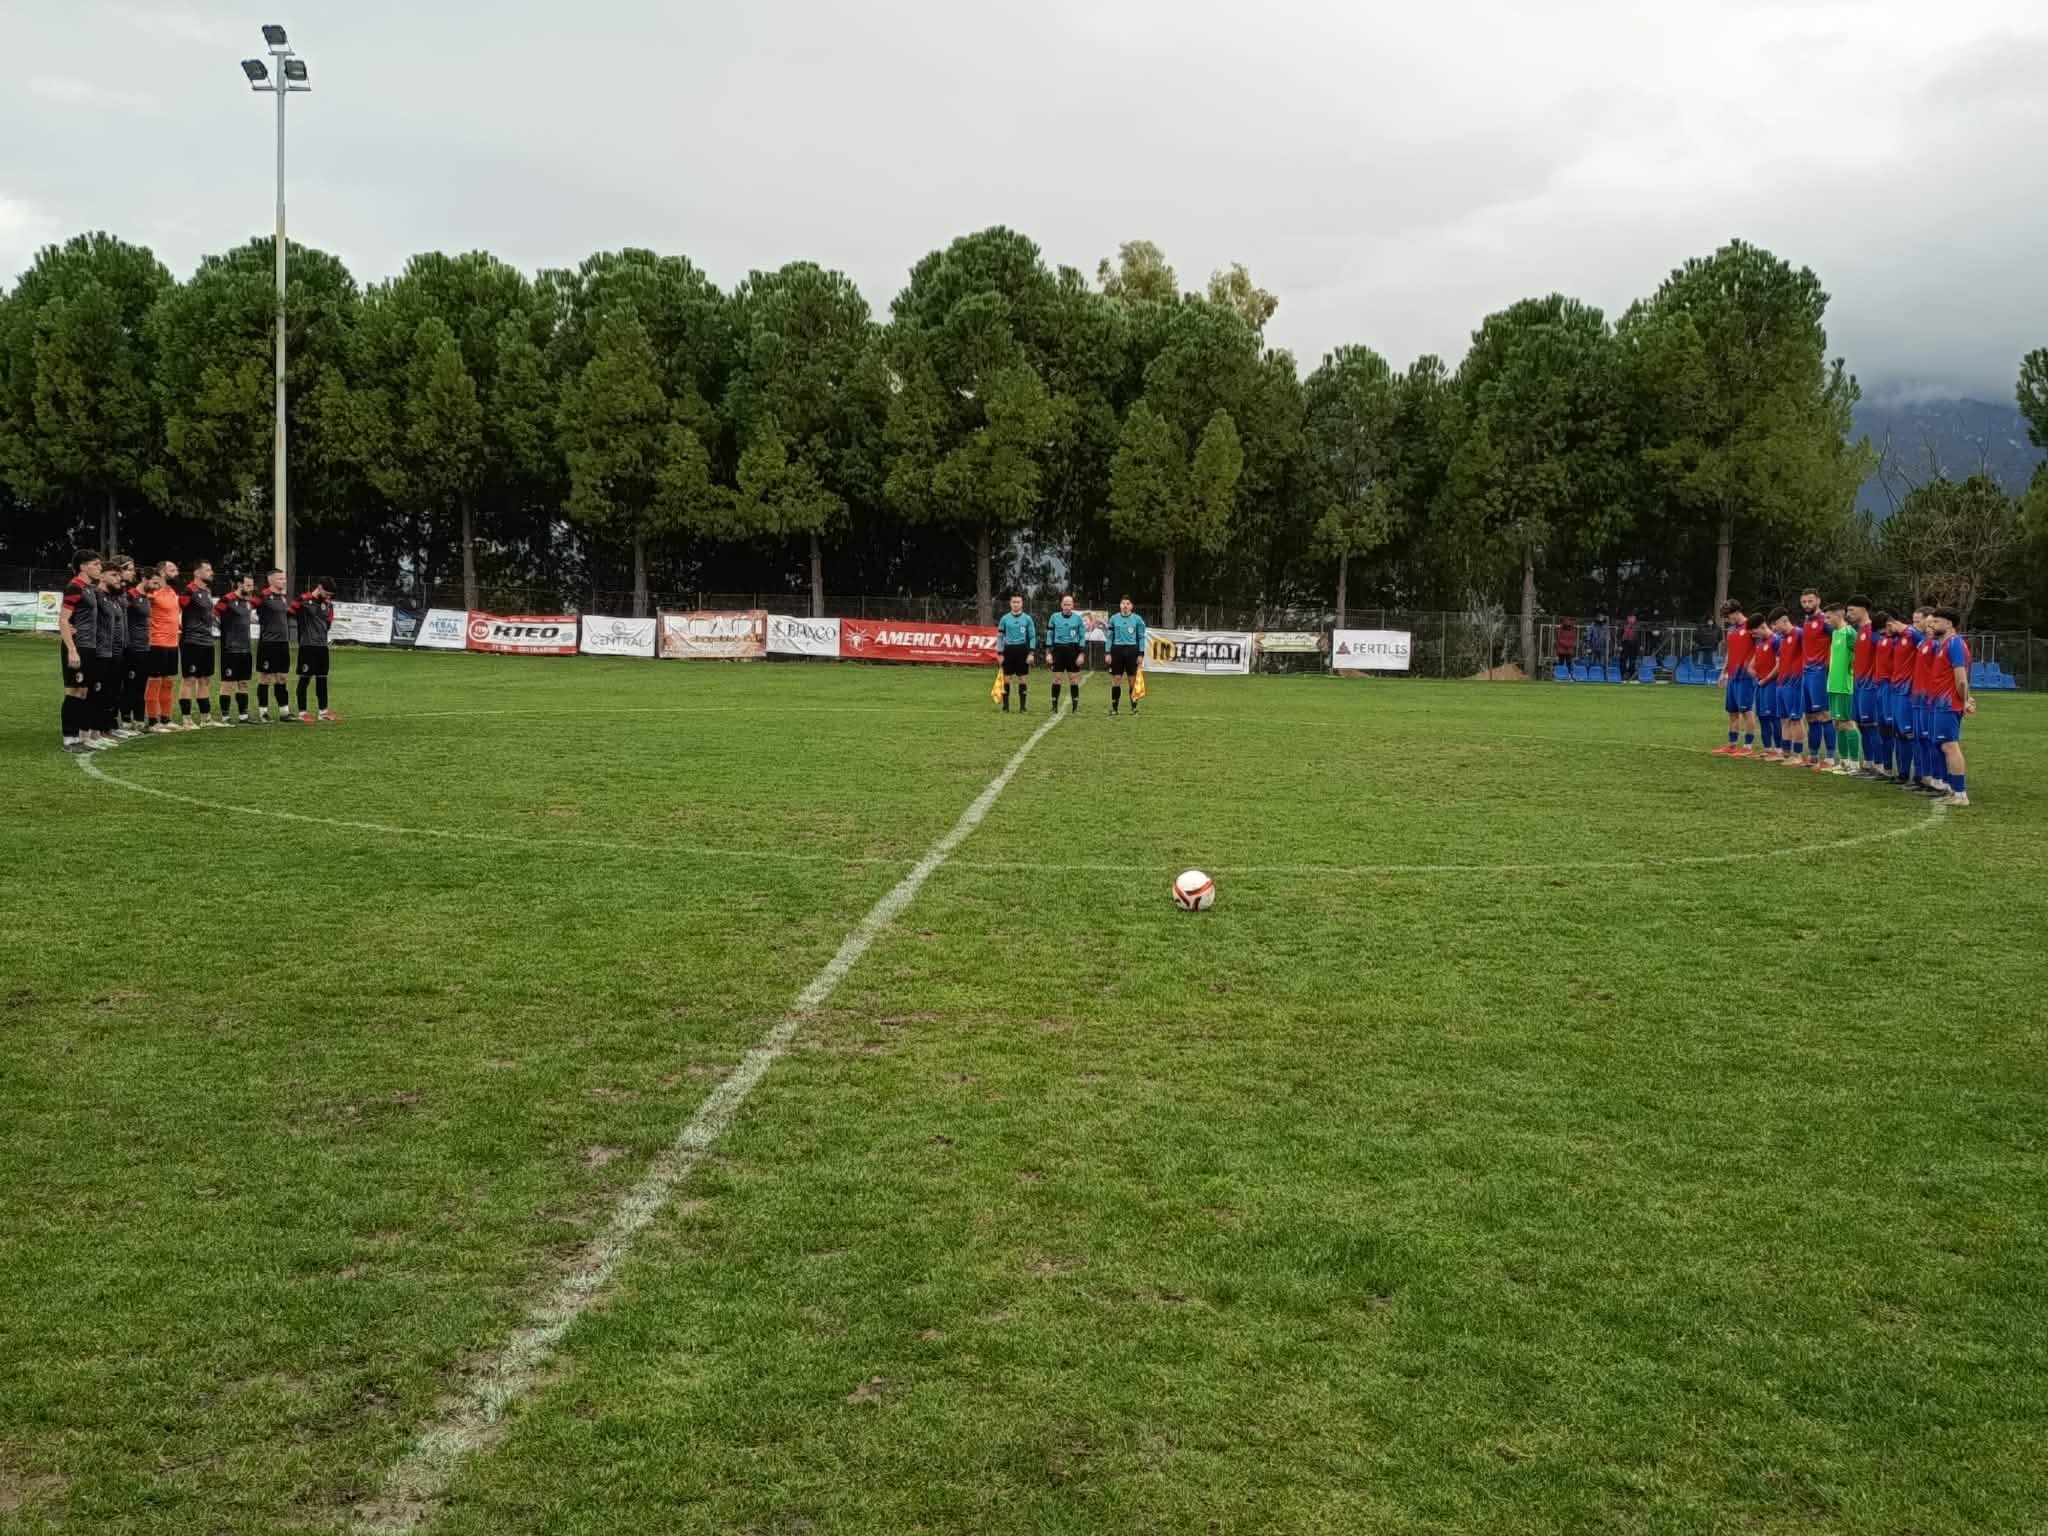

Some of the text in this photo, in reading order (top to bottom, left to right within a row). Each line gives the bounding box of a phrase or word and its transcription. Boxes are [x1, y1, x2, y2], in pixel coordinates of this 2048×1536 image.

[590, 634, 646, 648] CENTRAL
[874, 630, 999, 651] AMERICAN PIZ
[1352, 642, 1409, 656] FERTILIS
